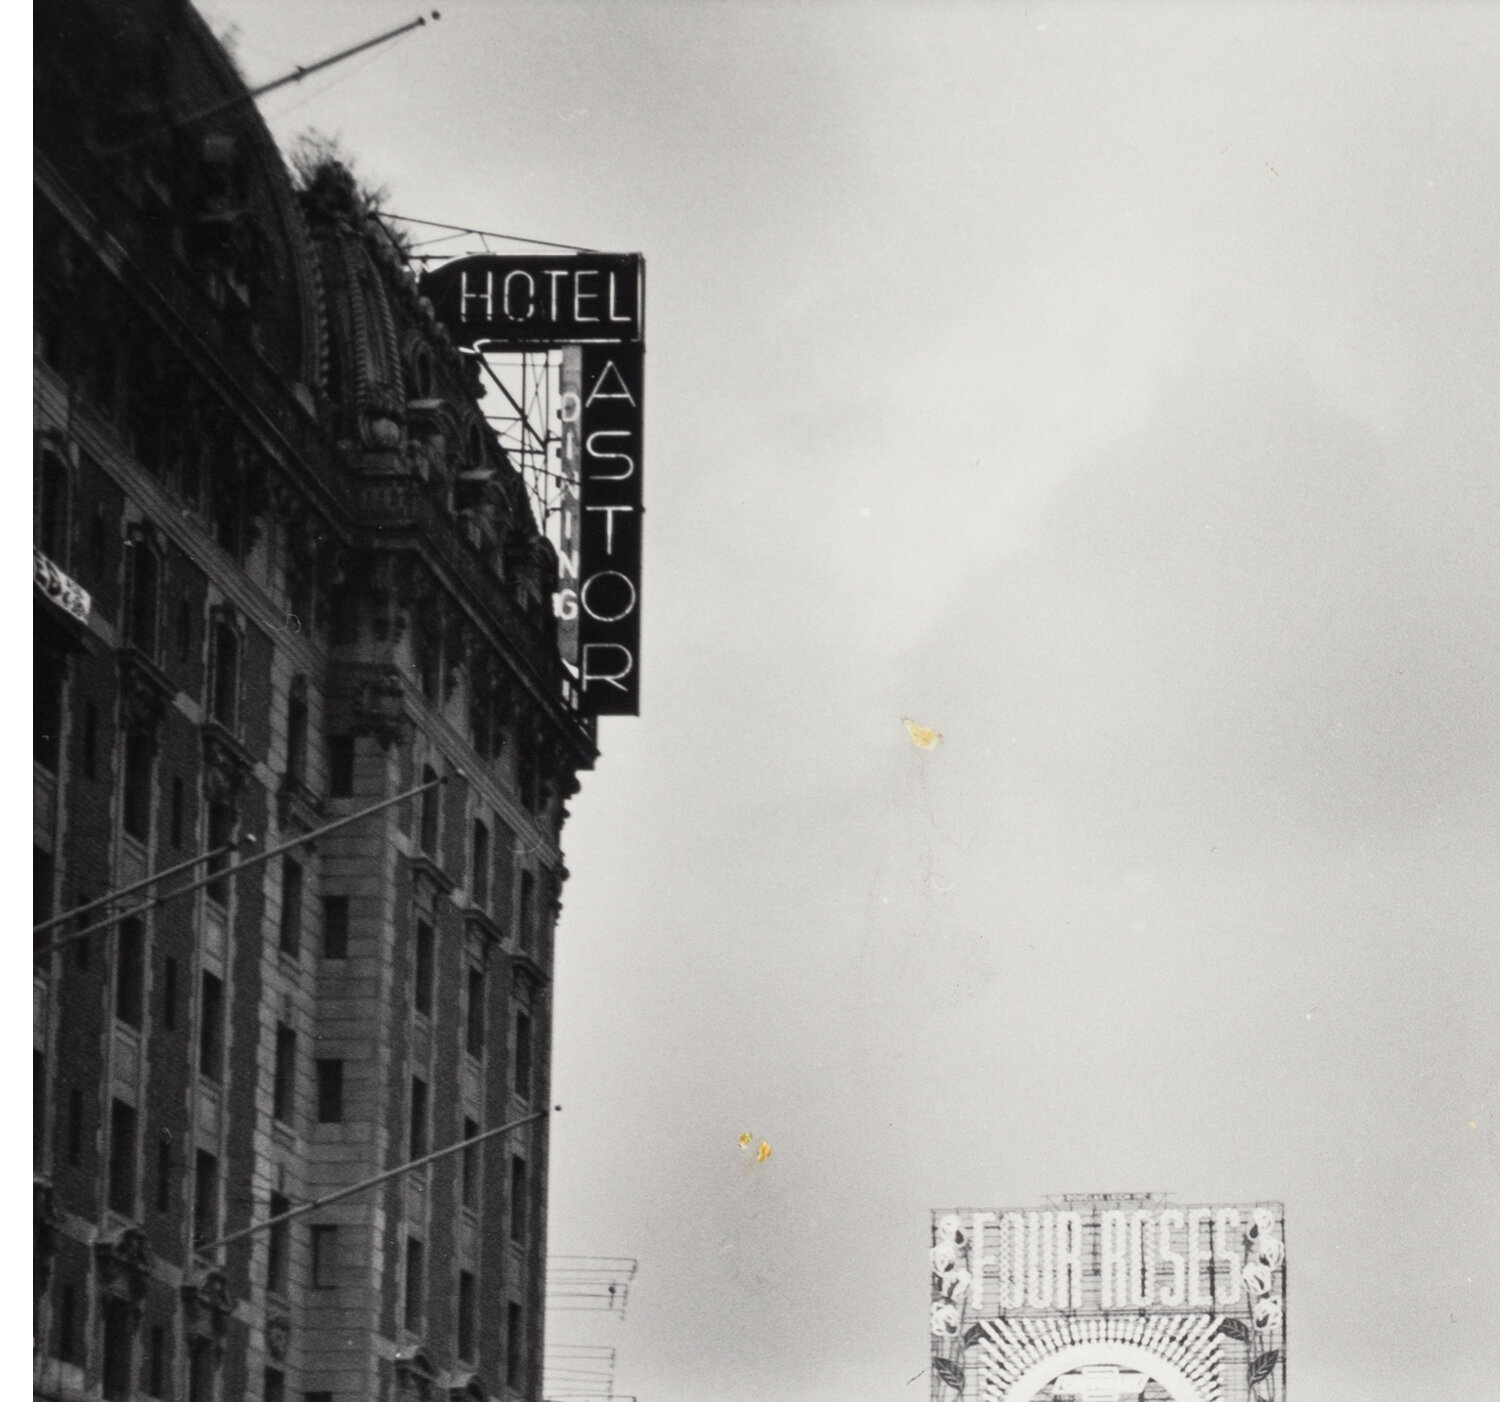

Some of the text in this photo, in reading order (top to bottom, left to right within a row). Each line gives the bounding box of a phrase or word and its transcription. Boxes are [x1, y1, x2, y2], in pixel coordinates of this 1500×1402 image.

[460, 270, 631, 322] HOTEL
[580, 359, 637, 692] ASTOR
[972, 1207, 1241, 1310] FOUR ROSES
